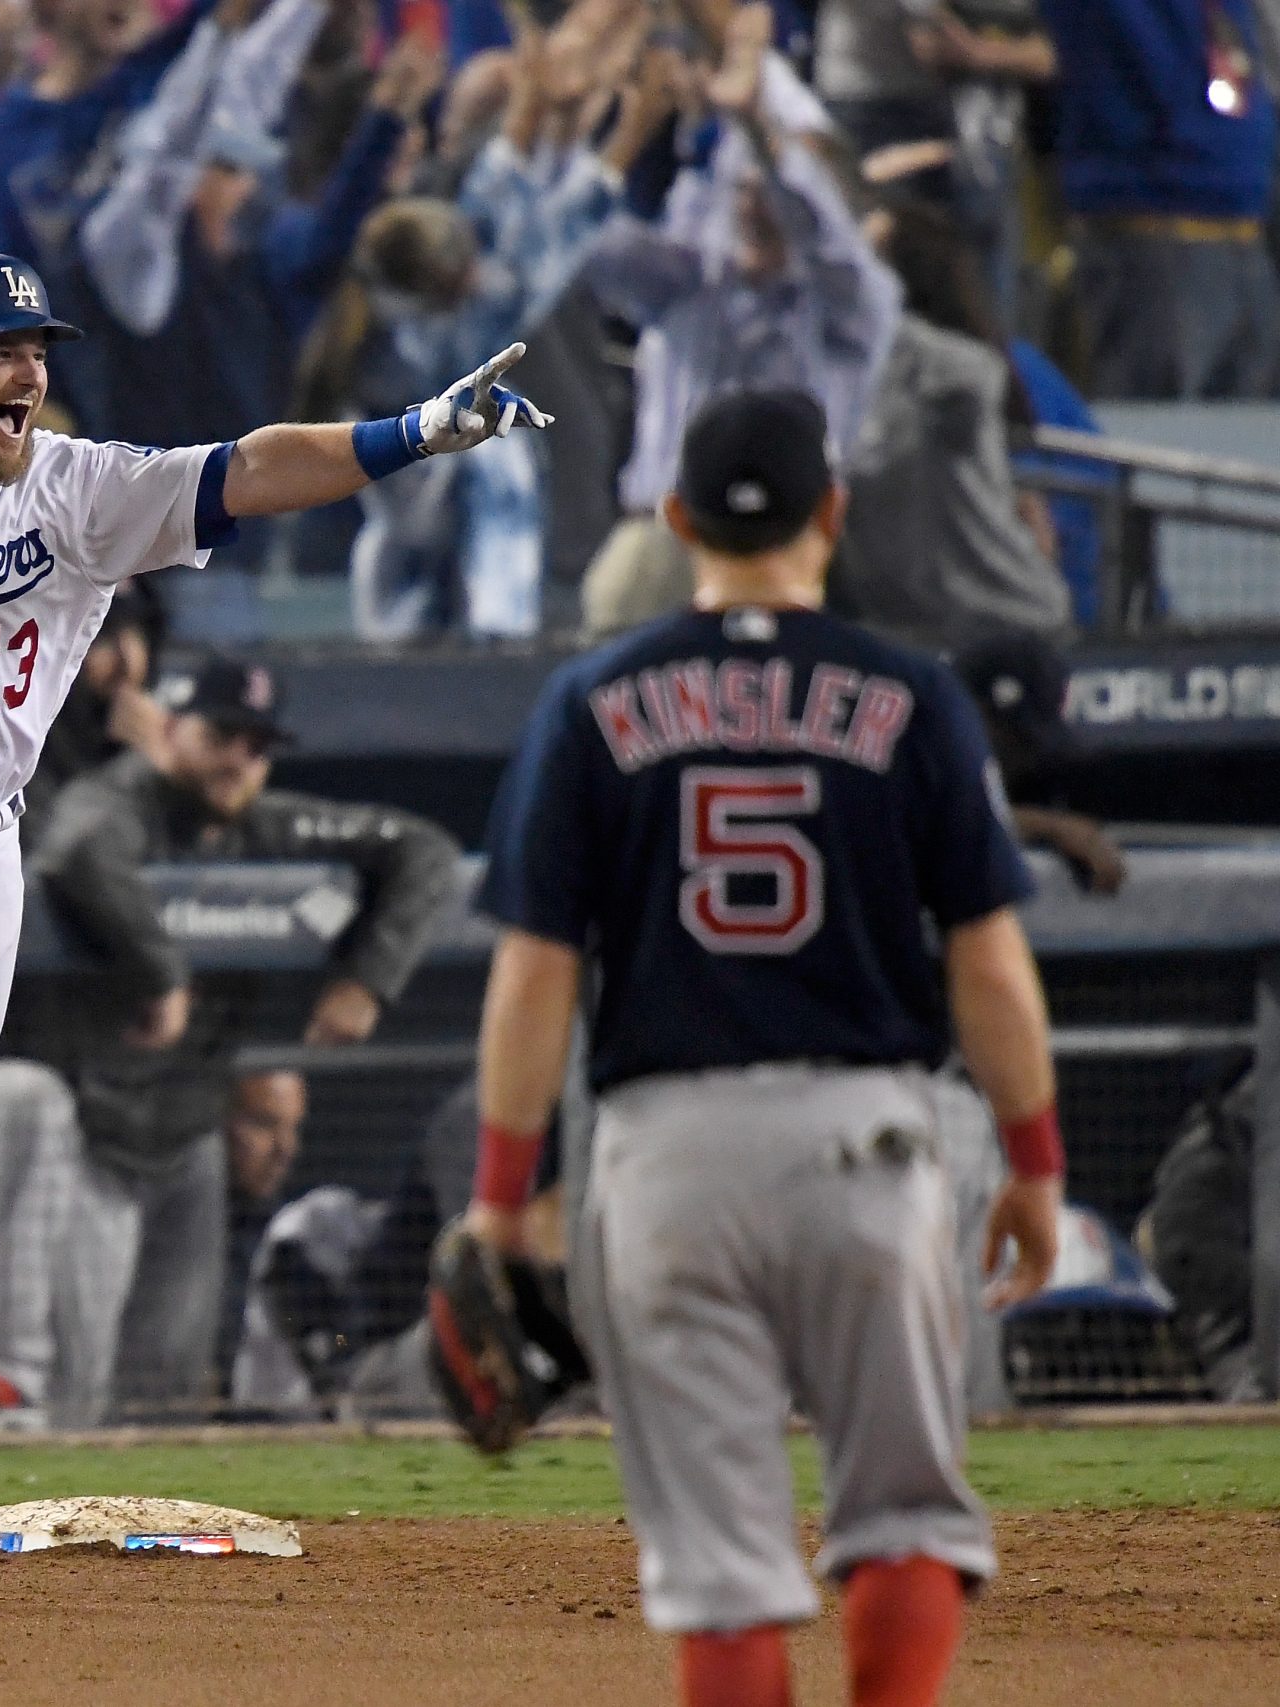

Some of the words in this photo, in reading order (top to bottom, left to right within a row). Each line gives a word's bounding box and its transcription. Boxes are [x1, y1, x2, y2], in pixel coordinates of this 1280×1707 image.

[0, 266, 39, 307] LA
[588, 656, 915, 774] KINSLER
[679, 765, 825, 955] 5
